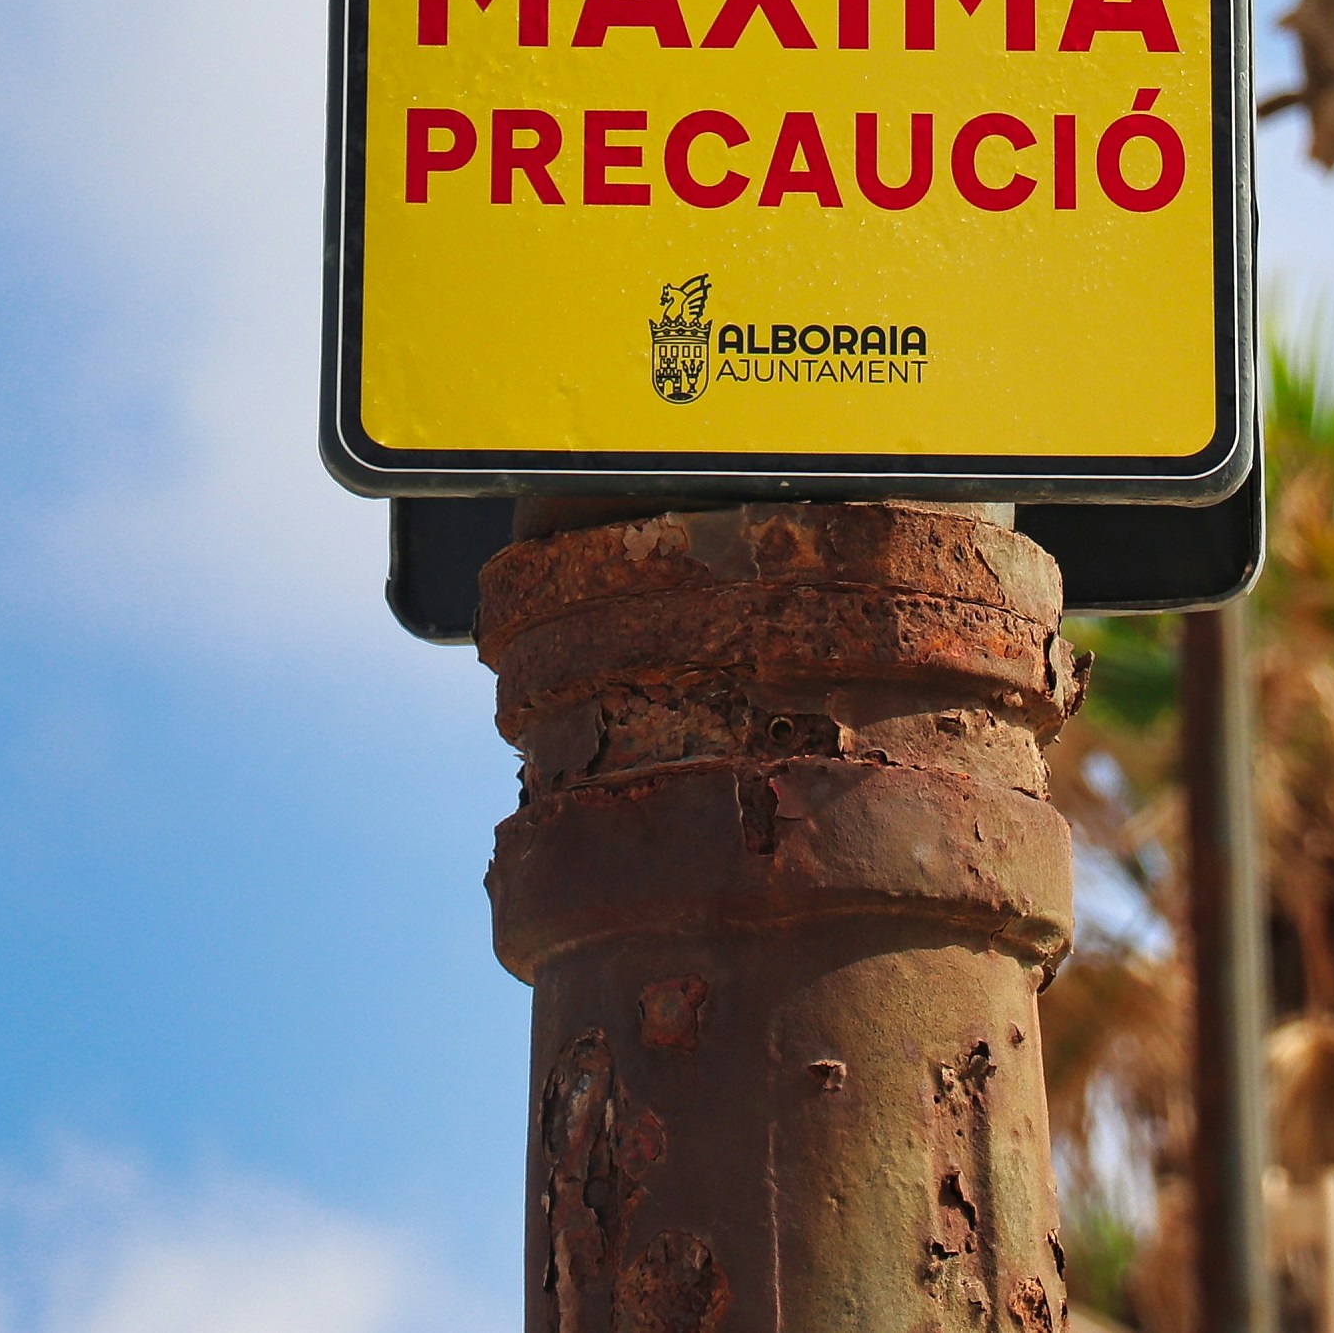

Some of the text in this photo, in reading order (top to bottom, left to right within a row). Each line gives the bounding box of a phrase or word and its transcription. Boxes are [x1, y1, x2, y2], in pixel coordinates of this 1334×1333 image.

[404, 87, 1186, 213] PRECAUCIÓ
[717, 323, 927, 356] ALBORAIA
[715, 358, 929, 385] AJUNTAMENT
